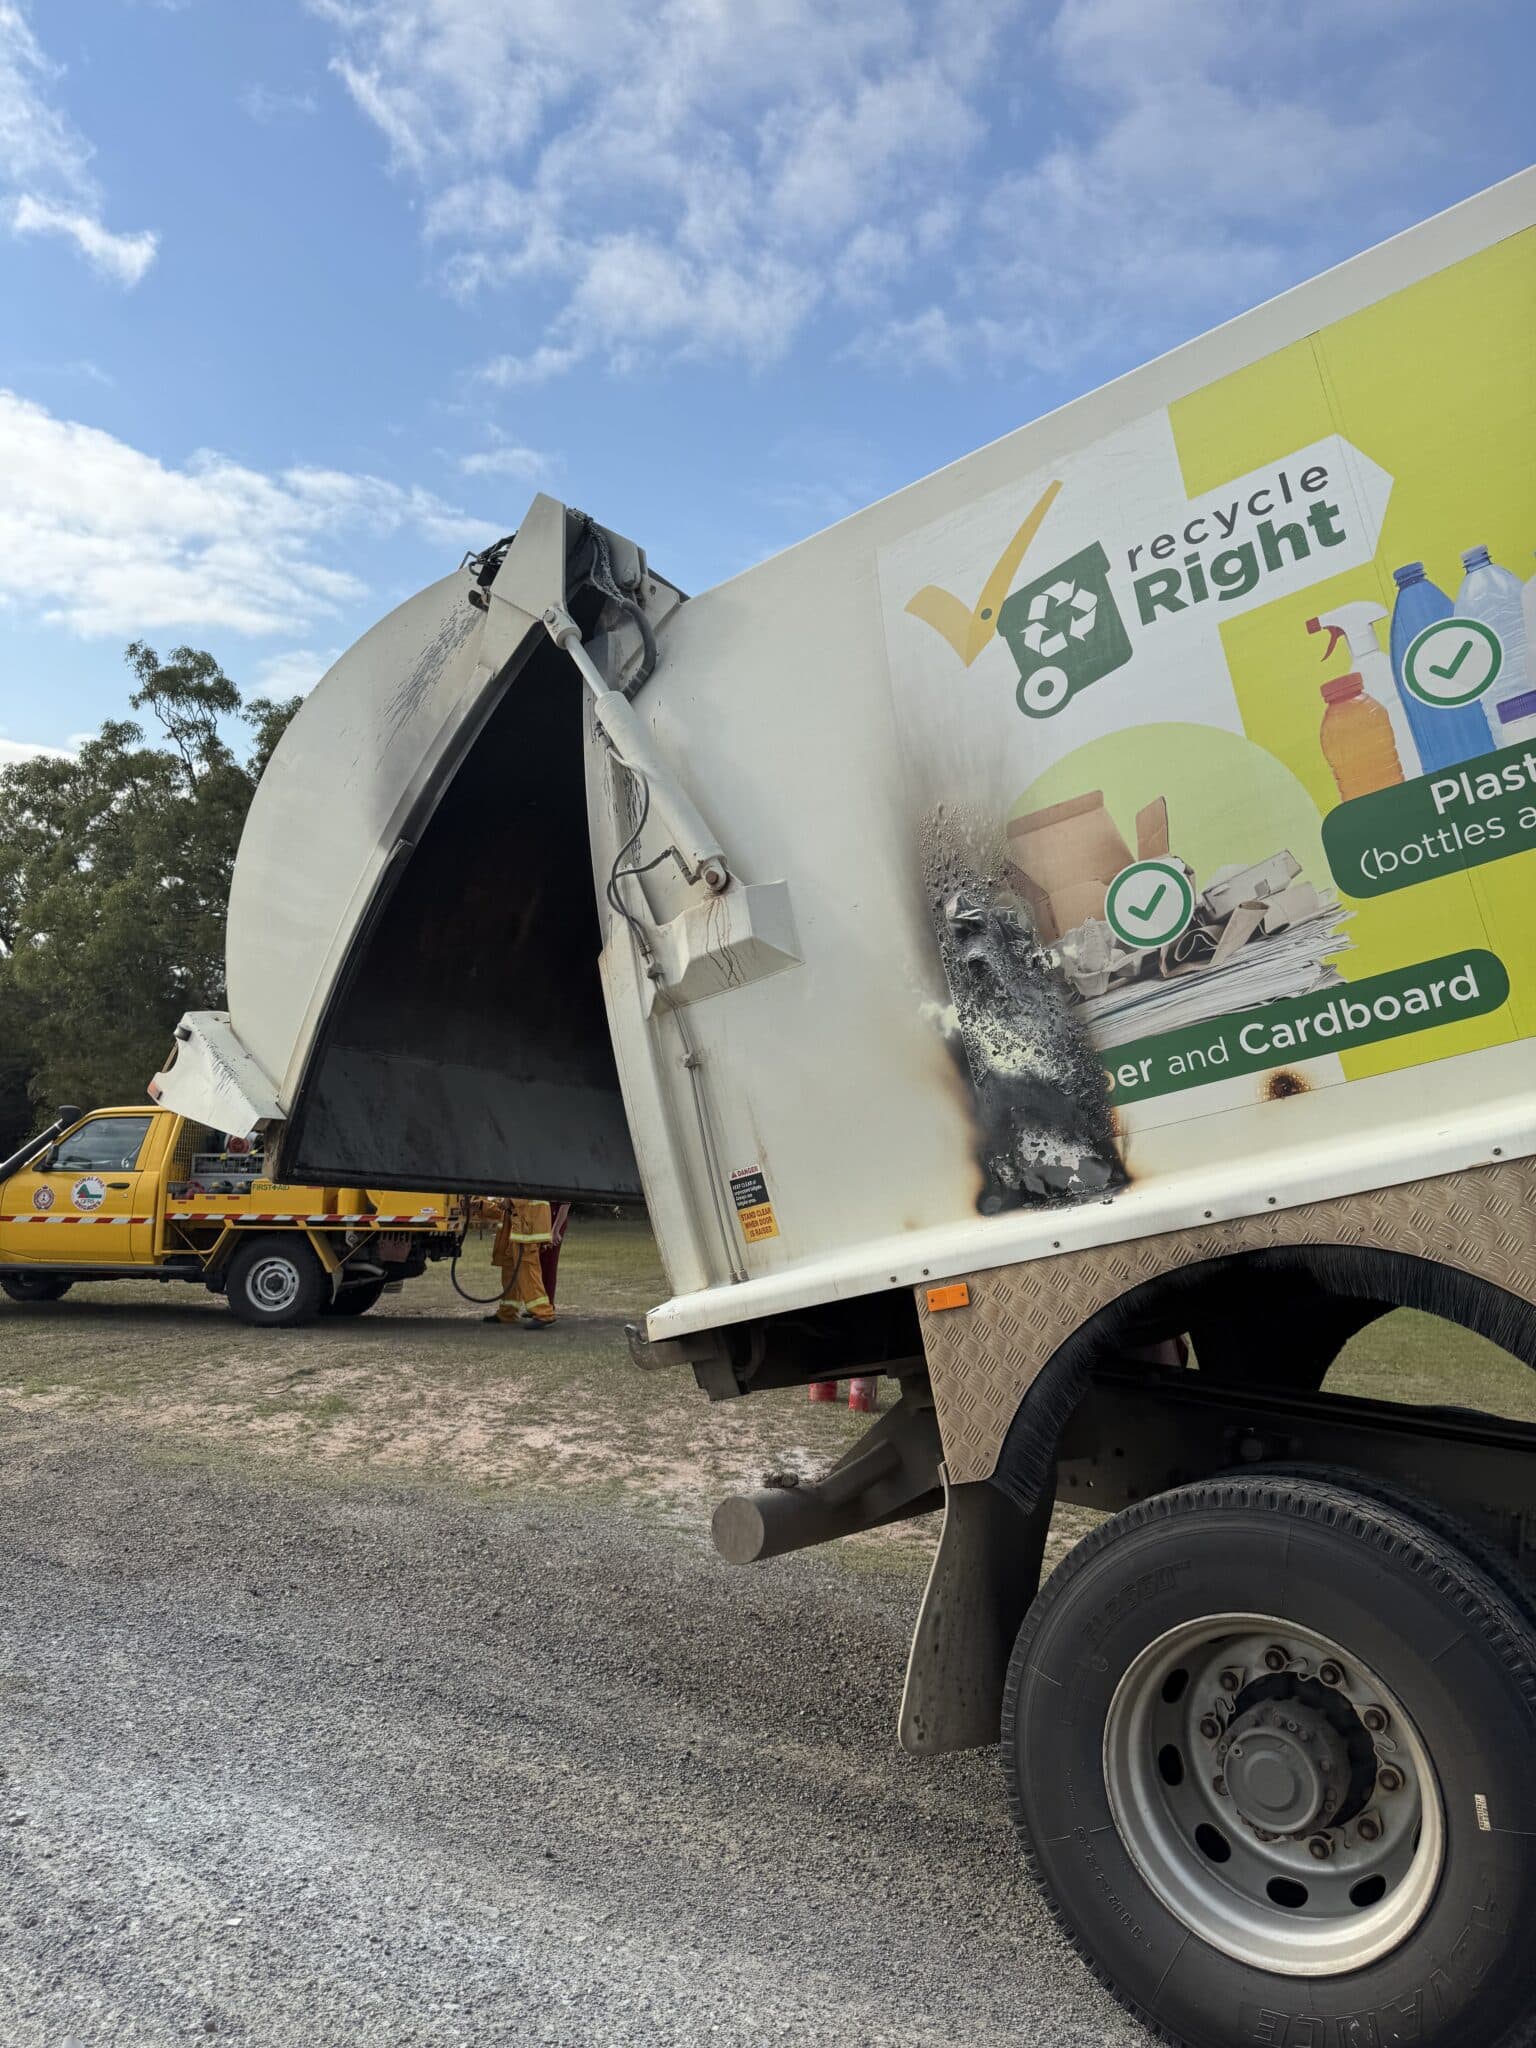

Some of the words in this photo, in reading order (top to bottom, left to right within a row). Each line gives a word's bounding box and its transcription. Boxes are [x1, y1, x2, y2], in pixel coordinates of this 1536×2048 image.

[1127, 465, 1328, 572] recycle
[1132, 499, 1347, 626] Right
[1360, 817, 1506, 880] (bottles
[1167, 1036, 1230, 1075] and
[1238, 964, 1480, 1055] Cardboard
[738, 1166, 759, 1176] DANGER
[252, 1183, 272, 1191] FIRST
[741, 1210, 757, 1221] STAND
[756, 1207, 772, 1218] CLEAR
[744, 1219, 759, 1229] WHEN
[759, 1216, 773, 1226] DOOR
[750, 1230, 756, 1238] IS
[755, 1226, 773, 1236] RAISED
